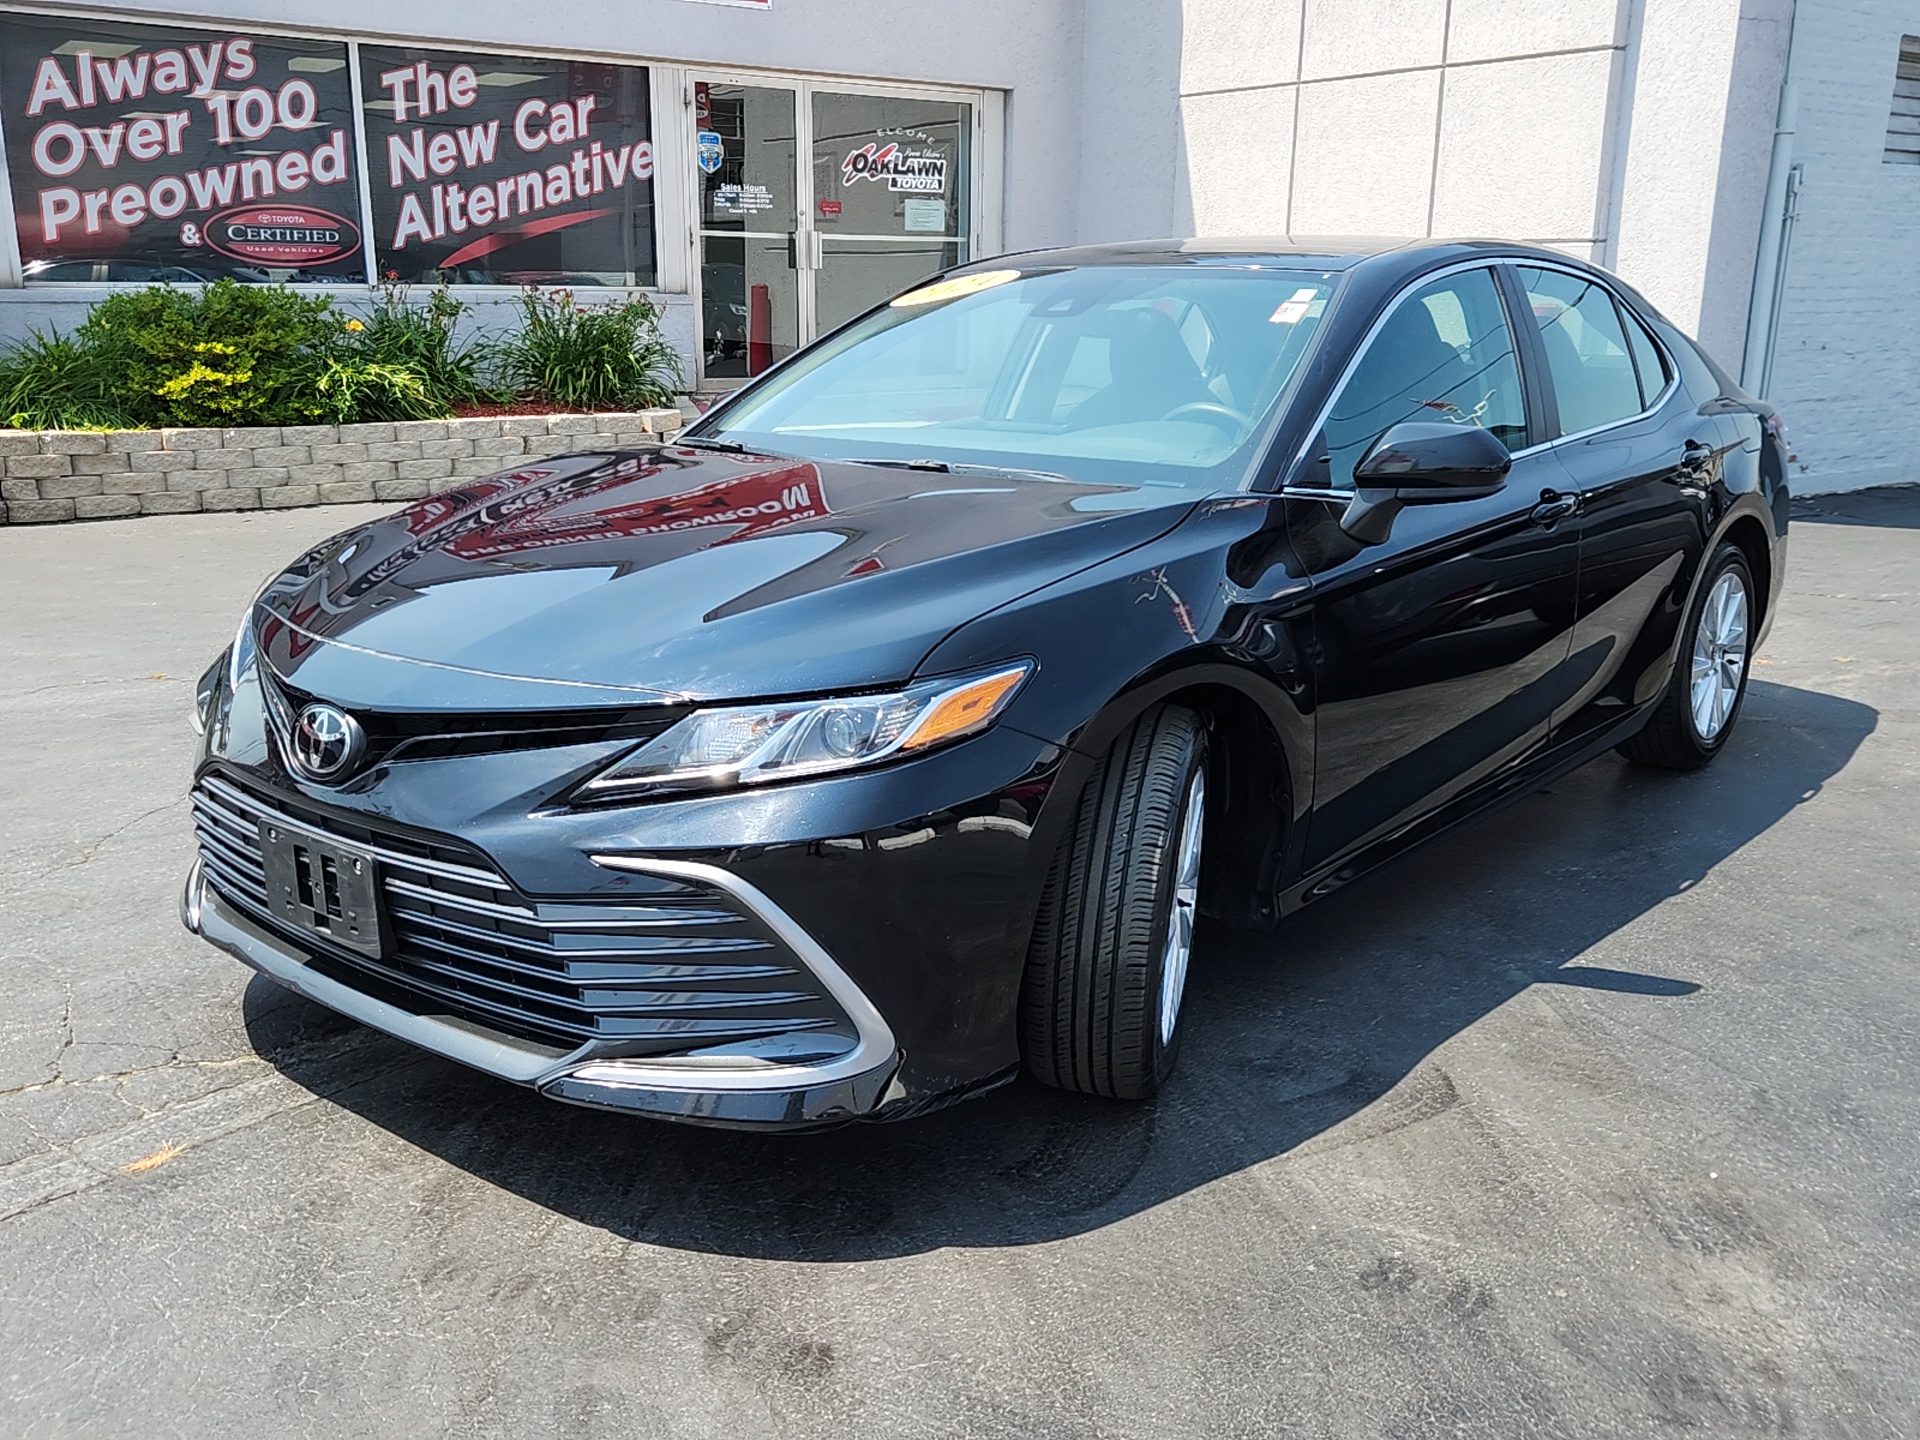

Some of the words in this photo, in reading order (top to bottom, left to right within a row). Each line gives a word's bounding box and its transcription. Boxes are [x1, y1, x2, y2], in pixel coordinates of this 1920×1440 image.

[26, 37, 257, 117] Always
[380, 61, 477, 123] The
[32, 110, 191, 177] Over
[208, 78, 317, 145] 100
[387, 119, 499, 187] New
[513, 94, 596, 152] Car
[40, 130, 348, 243] Preowned
[392, 140, 654, 250] Alternative
[720, 183, 741, 191] Sales
[743, 183, 766, 192] Hours
[895, 178, 939, 189] TOYOTA
[180, 222, 203, 247] &
[227, 225, 340, 242] CERTIFIED
[272, 215, 305, 224] TOYOTA
